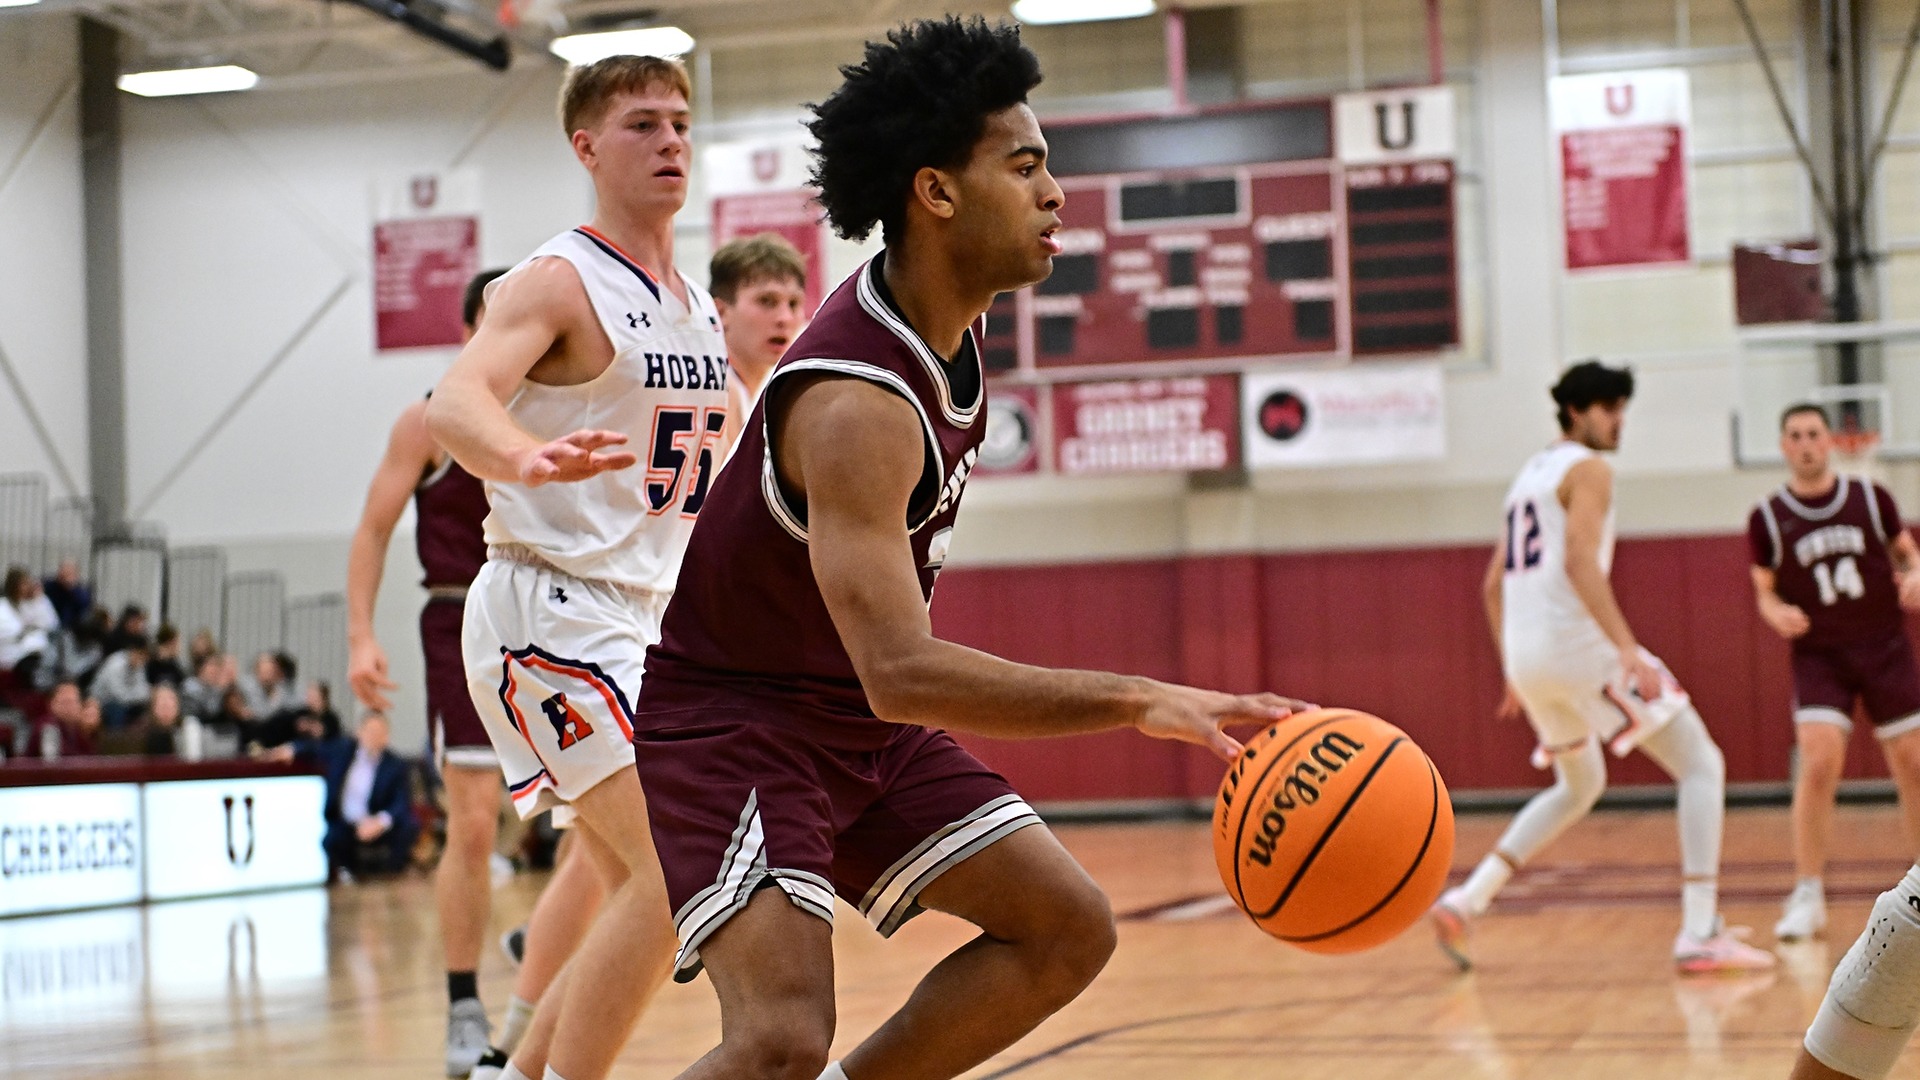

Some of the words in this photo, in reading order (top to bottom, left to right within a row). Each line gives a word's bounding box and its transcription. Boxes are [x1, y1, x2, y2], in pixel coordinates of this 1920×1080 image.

[1373, 101, 1415, 150] U
[1604, 84, 1633, 116] U
[643, 404, 728, 521] 55
[1504, 500, 1541, 570] 12
[1813, 555, 1865, 606] 14
[223, 796, 253, 865] U
[1248, 731, 1364, 867] Wilson
[1, 820, 135, 878] CHARGERS
